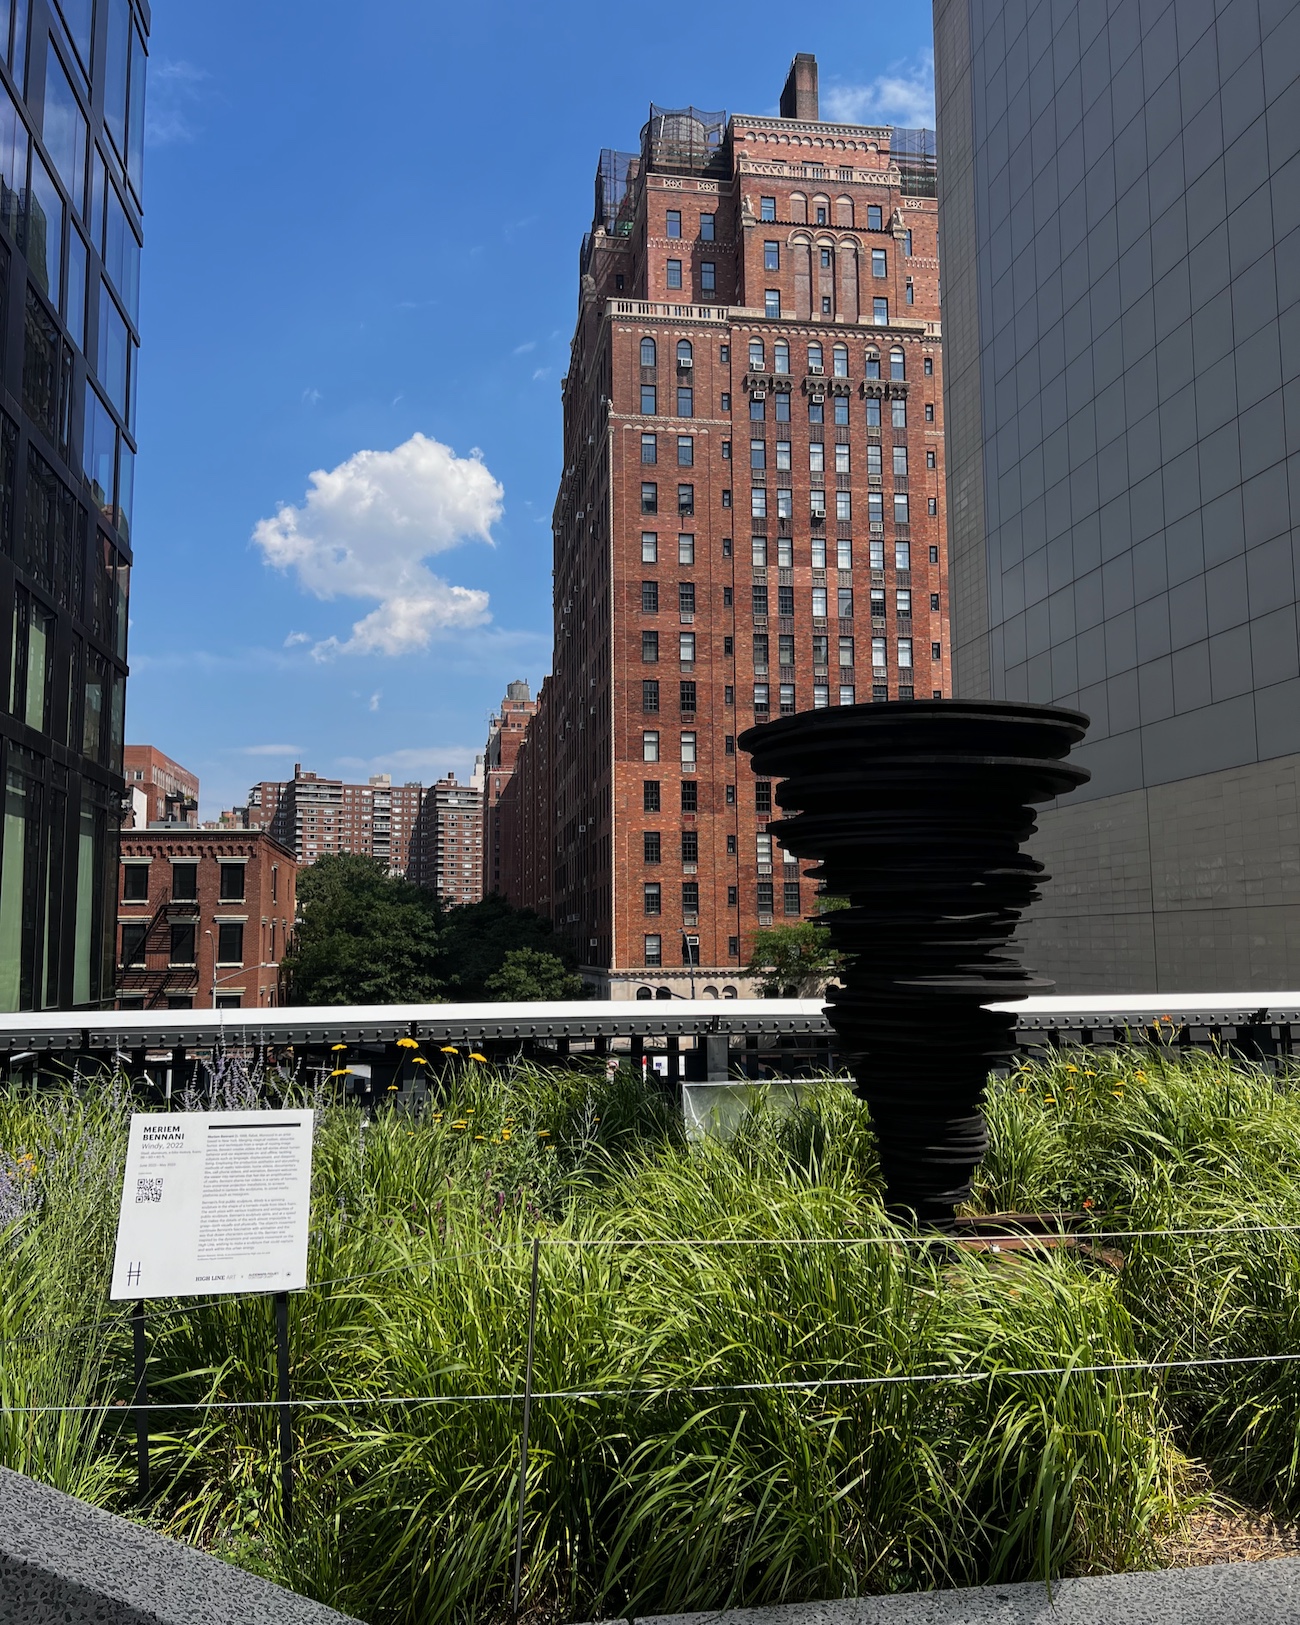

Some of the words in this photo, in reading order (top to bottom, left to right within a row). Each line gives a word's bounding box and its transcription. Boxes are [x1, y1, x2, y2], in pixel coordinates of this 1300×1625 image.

[143, 1125, 181, 1133] MERIEM
[142, 1133, 185, 1141] BENNANI
[141, 1142, 164, 1150] Windy,
